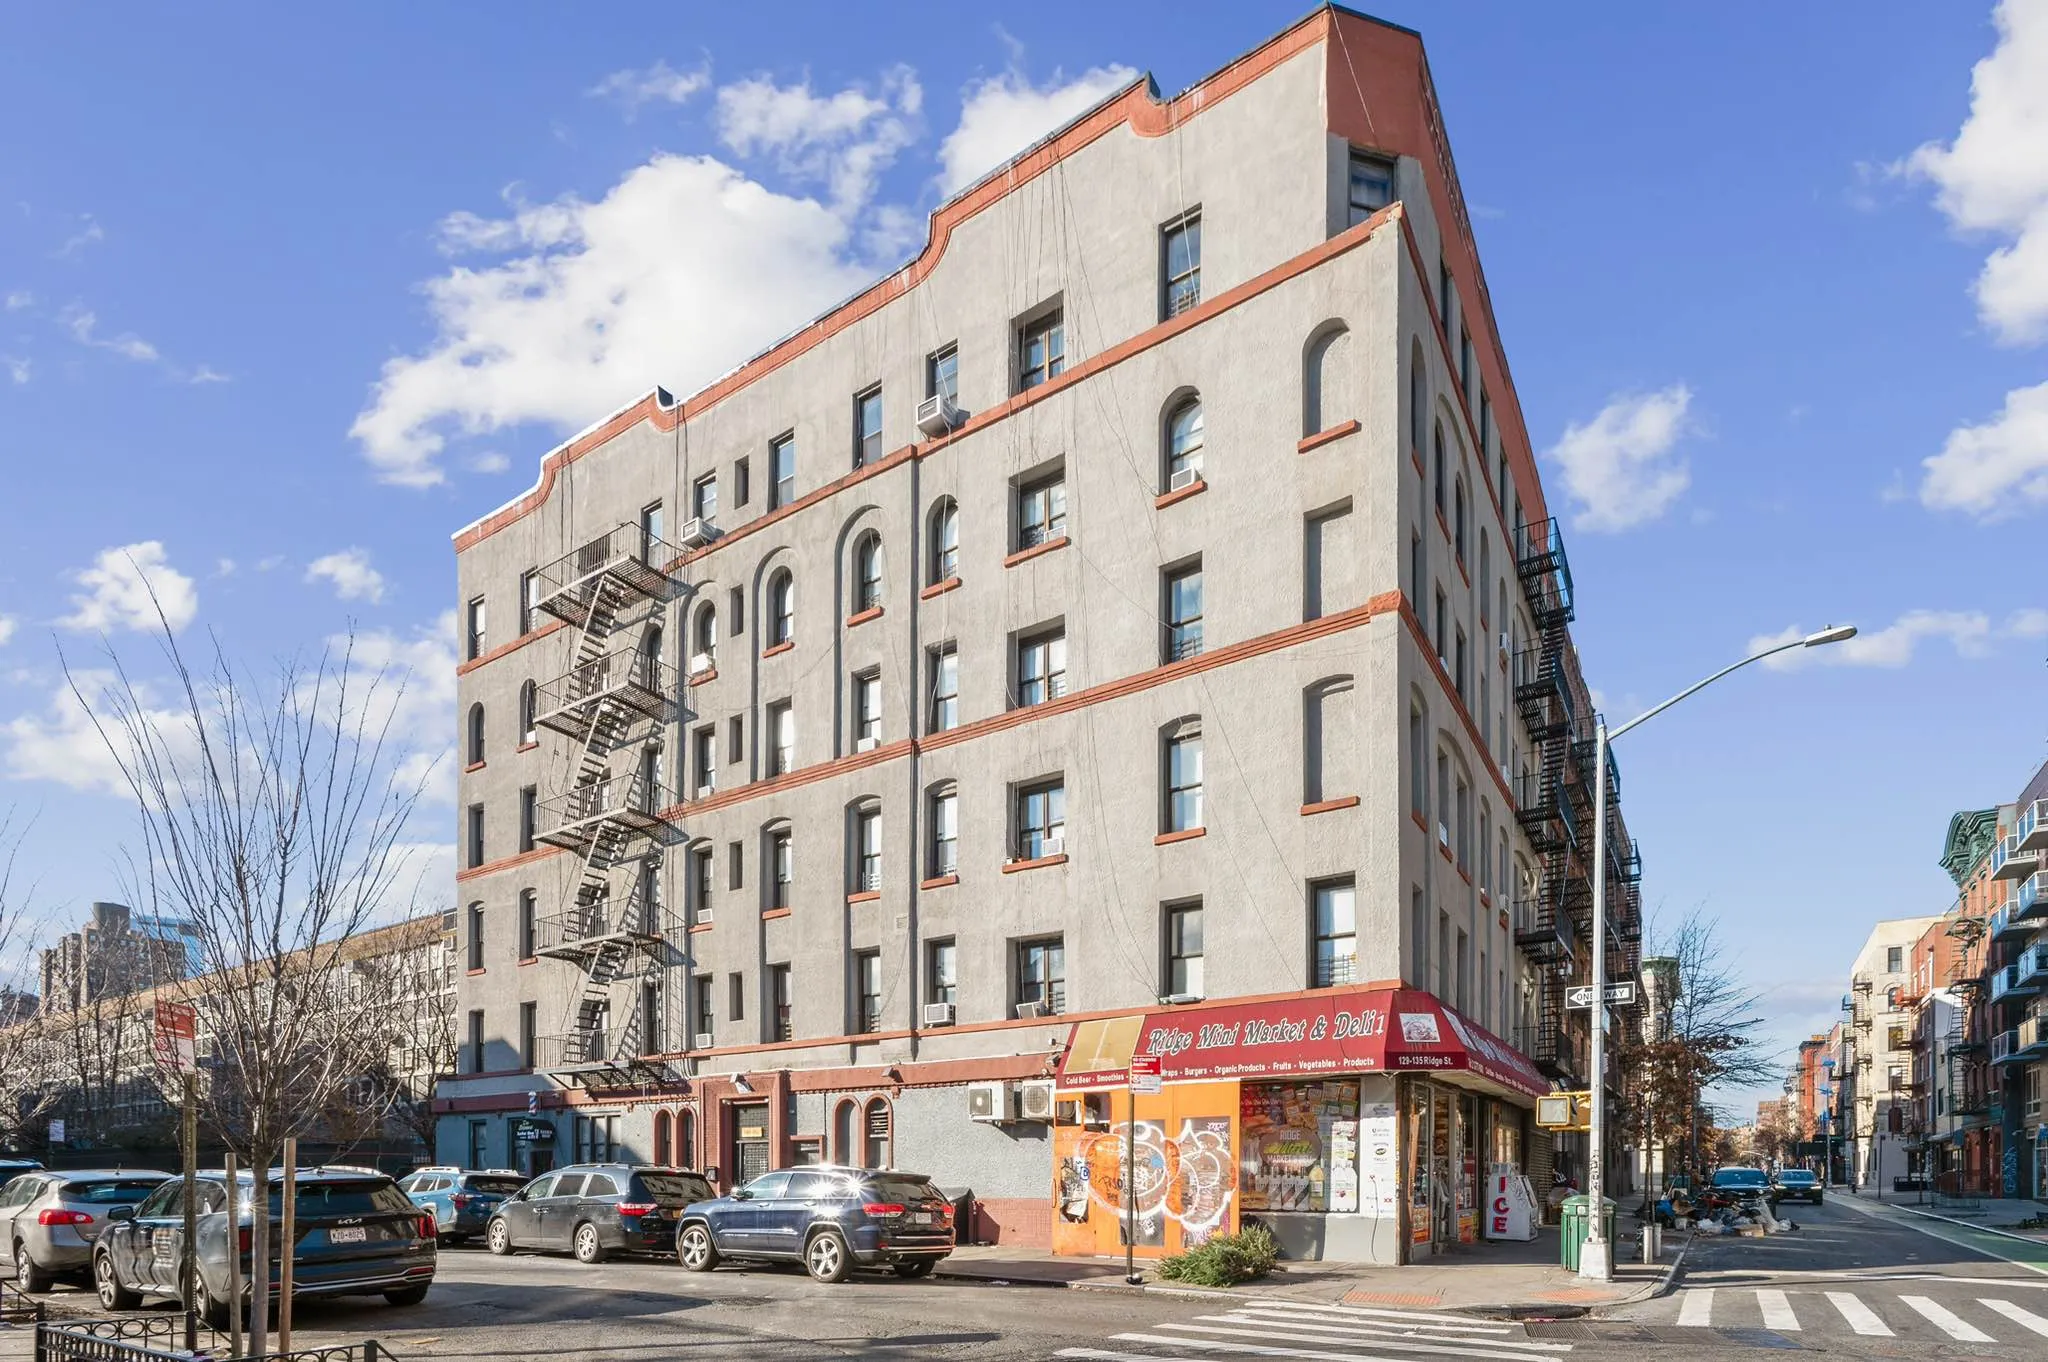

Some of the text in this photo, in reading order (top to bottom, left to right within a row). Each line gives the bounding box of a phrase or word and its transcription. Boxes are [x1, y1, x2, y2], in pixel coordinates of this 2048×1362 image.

[1576, 989, 1625, 1001] ONE WAY
[1146, 1027, 1193, 1056] Ridge
[1196, 1022, 1240, 1049] Mini
[1242, 1017, 1307, 1045] Market
[1310, 1015, 1327, 1040] &
[1332, 1009, 1376, 1039] Deli
[1065, 1076, 1078, 1085] Cold
[1078, 1075, 1091, 1084] Beer
[1096, 1073, 1124, 1083] Smoothies
[1185, 1067, 1207, 1077] Burgers
[1214, 1065, 1237, 1075] Organic
[1238, 1063, 1266, 1072] Products
[1273, 1061, 1291, 1071] Fruits
[1299, 1060, 1336, 1069] Vegetables
[1343, 1057, 1374, 1066] Products
[1398, 1056, 1453, 1067] 129-135 Ridge St.
[1280, 1129, 1300, 1140] RIDGE
[1492, 1176, 1510, 1233] ICE
